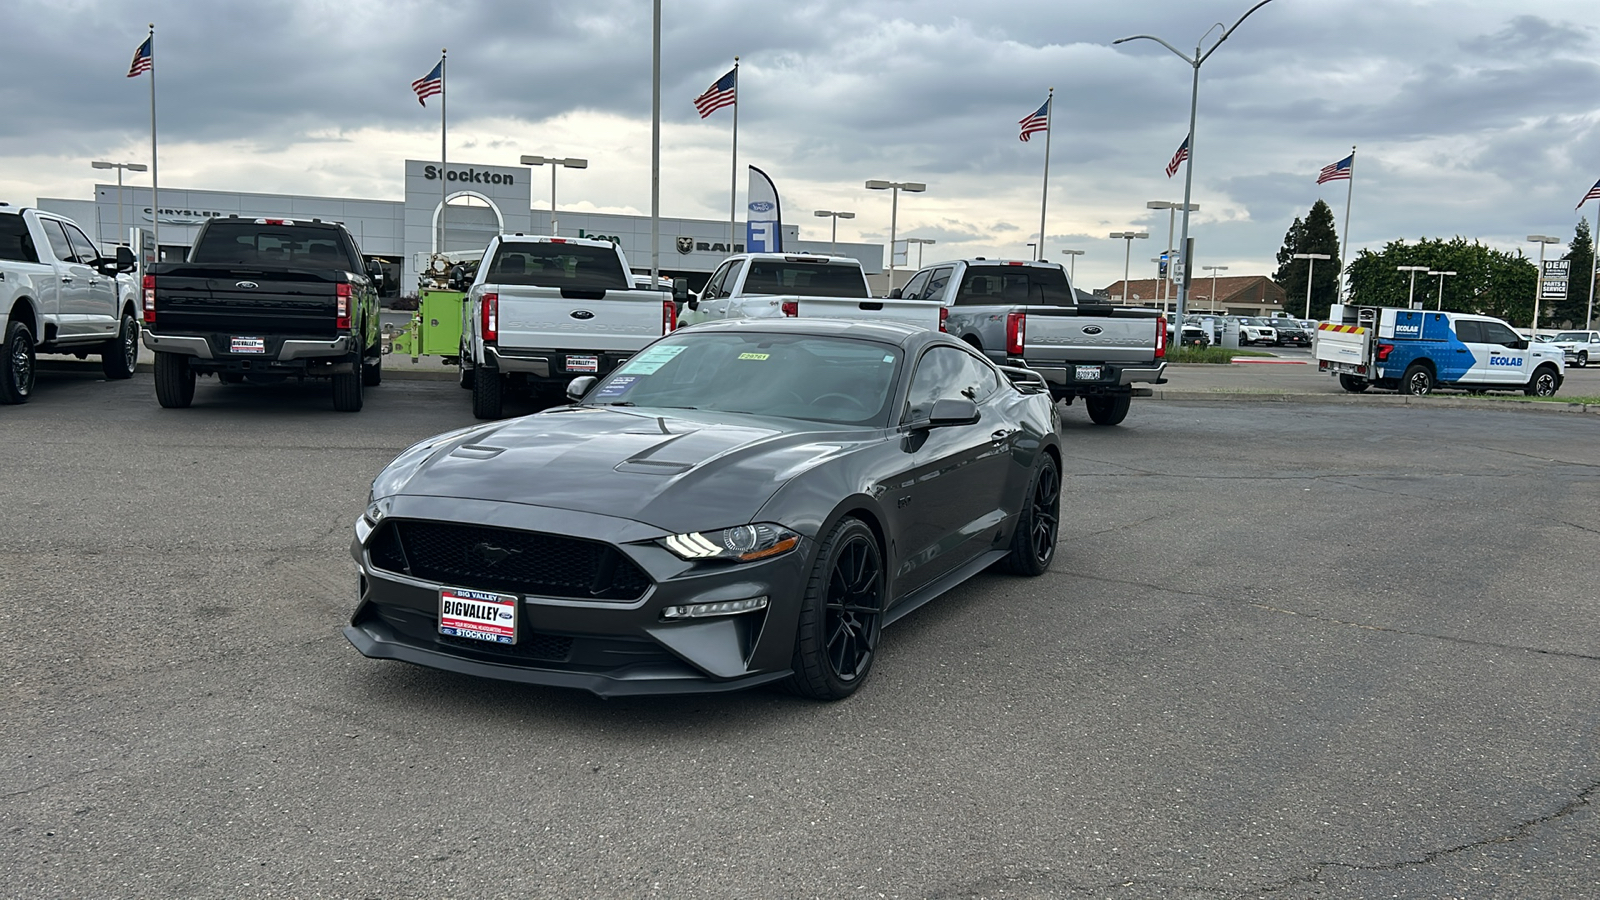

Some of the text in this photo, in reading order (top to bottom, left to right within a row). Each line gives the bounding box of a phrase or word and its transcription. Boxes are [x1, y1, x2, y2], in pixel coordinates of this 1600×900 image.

[424, 165, 514, 185] Stockton
[143, 208, 221, 217] CHRYSLER
[696, 242, 744, 253] RAM
[1545, 261, 1568, 269] OEM
[508, 320, 654, 333] SUPER DUTY
[1032, 335, 1150, 345] SUPER DUTY
[1489, 356, 1523, 366] ECOLAB
[457, 590, 498, 601] BIG VALLEY
[443, 600, 499, 621] BIGVALLEY
[456, 629, 498, 641] STOCKTON
